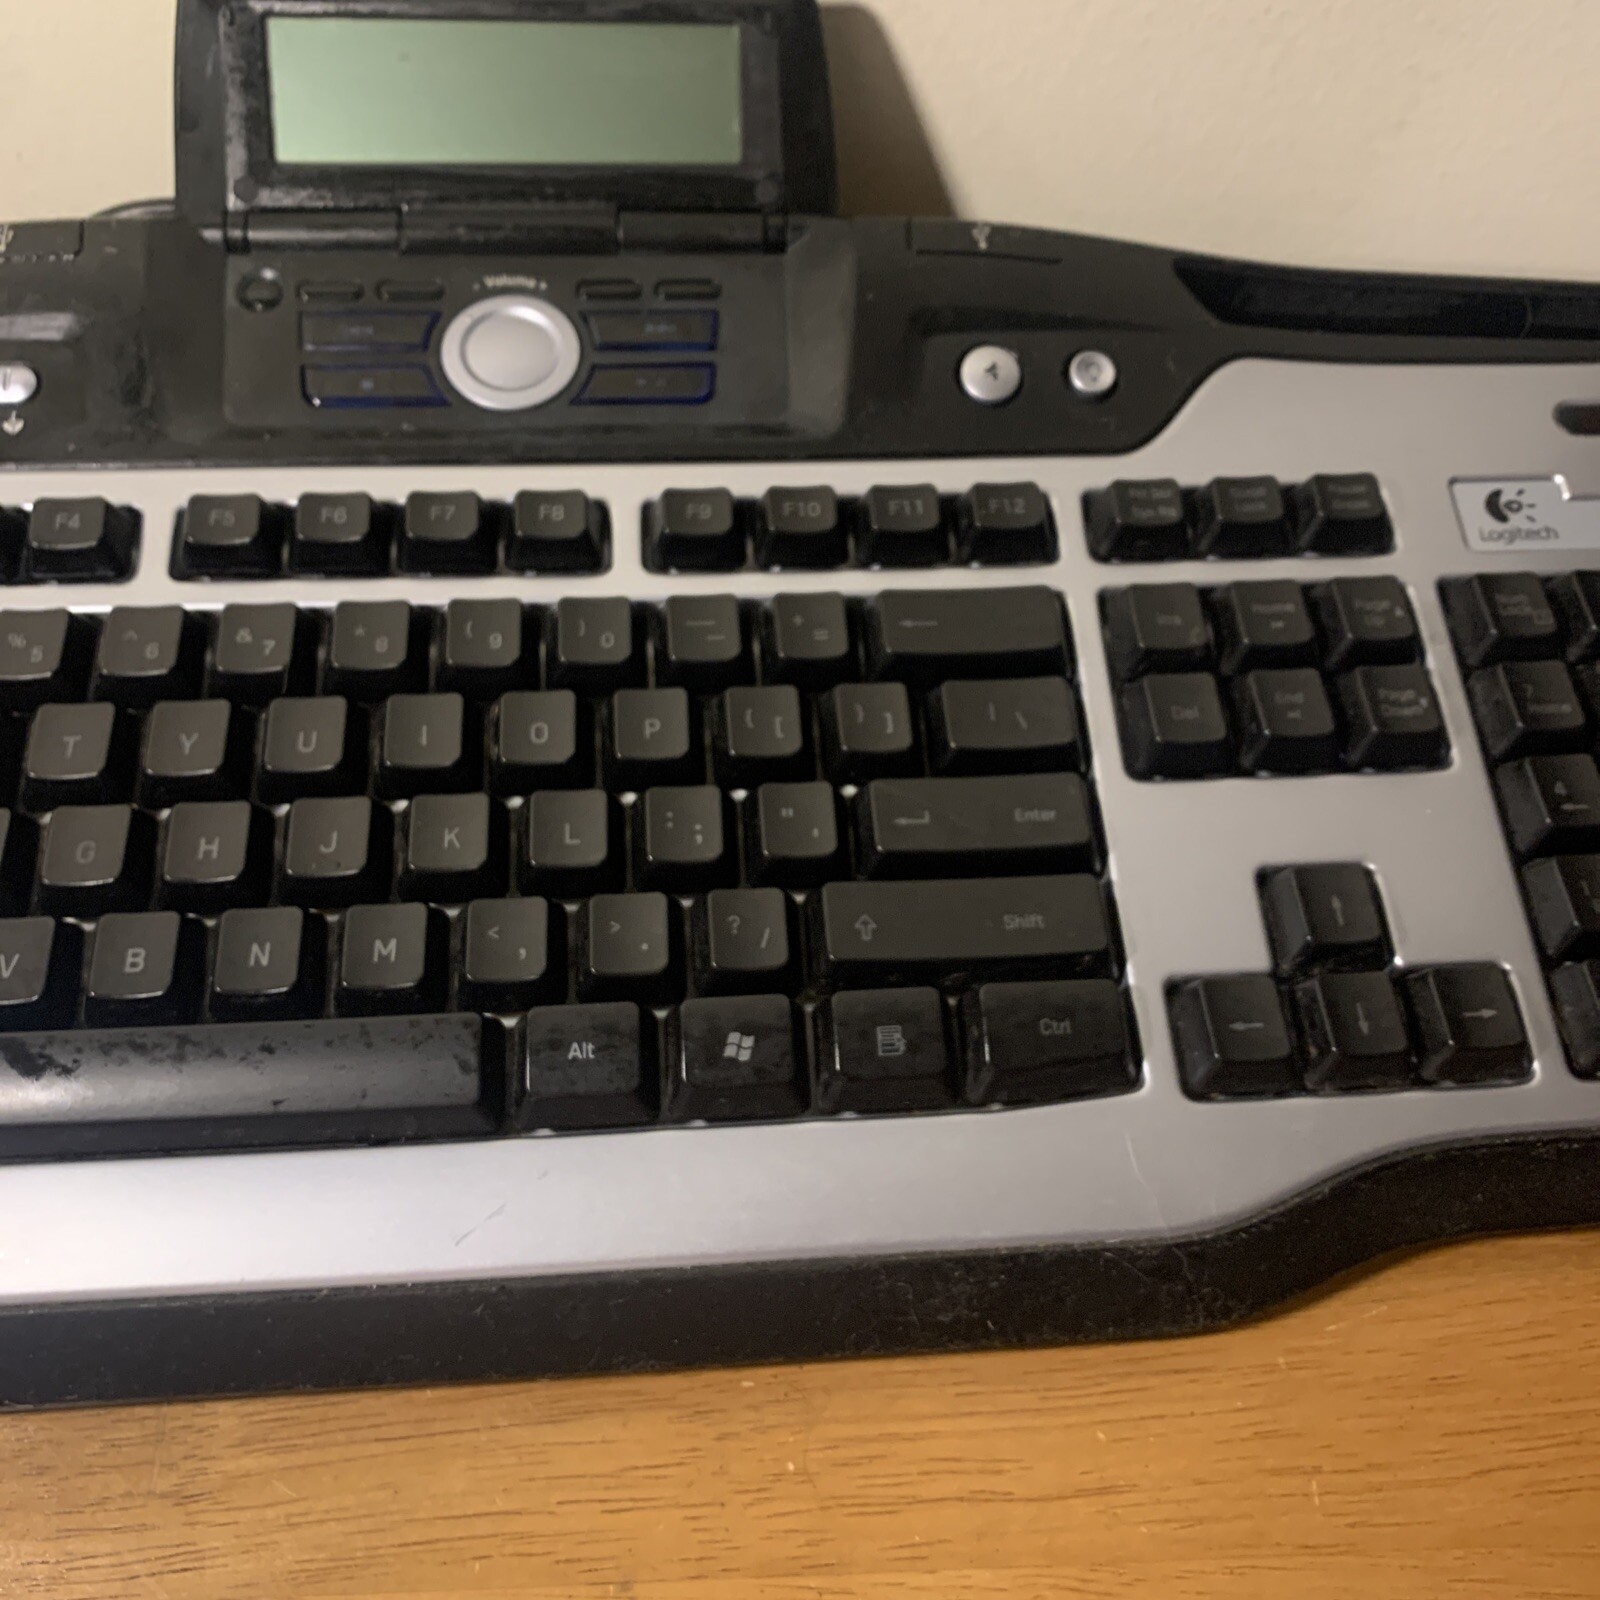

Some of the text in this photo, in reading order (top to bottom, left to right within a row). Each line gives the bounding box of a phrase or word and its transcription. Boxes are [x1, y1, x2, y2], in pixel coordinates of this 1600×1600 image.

[481, 273, 537, 289] Volume
[320, 505, 347, 525] F6
[430, 504, 456, 521] F7
[539, 503, 565, 521] F8
[686, 503, 712, 519] F9
[782, 501, 821, 518] F10
[888, 499, 923, 515] F11
[988, 498, 1027, 514] F12
[55, 512, 81, 531] F4
[208, 507, 236, 526] F5
[1477, 525, 1560, 545] Logitech
[236, 628, 253, 644] &
[489, 632, 502, 649] 9
[29, 646, 44, 663] 5
[144, 642, 160, 660] 6
[262, 639, 276, 656] 7
[420, 724, 428, 746] I
[529, 721, 549, 744] O
[642, 718, 661, 740] P
[63, 735, 82, 759] T
[178, 732, 199, 756] Y
[299, 730, 318, 754] U
[1013, 806, 1057, 823] Enter
[319, 830, 338, 853] J
[443, 827, 461, 849] K
[564, 823, 581, 845] L
[694, 823, 703, 845] ;
[75, 840, 96, 864] G
[197, 836, 220, 860] H
[610, 920, 622, 934] >
[726, 914, 741, 935] ?
[1002, 913, 1046, 930] Shift
[487, 926, 500, 940] <
[760, 927, 770, 949] /
[249, 941, 271, 967] N
[373, 938, 397, 964] M
[518, 946, 527, 960] ,
[640, 942, 649, 951] .
[0, 953, 20, 978] V
[124, 947, 146, 974] B
[1038, 1017, 1072, 1036] Ctrl
[567, 1041, 596, 1060] Alt
